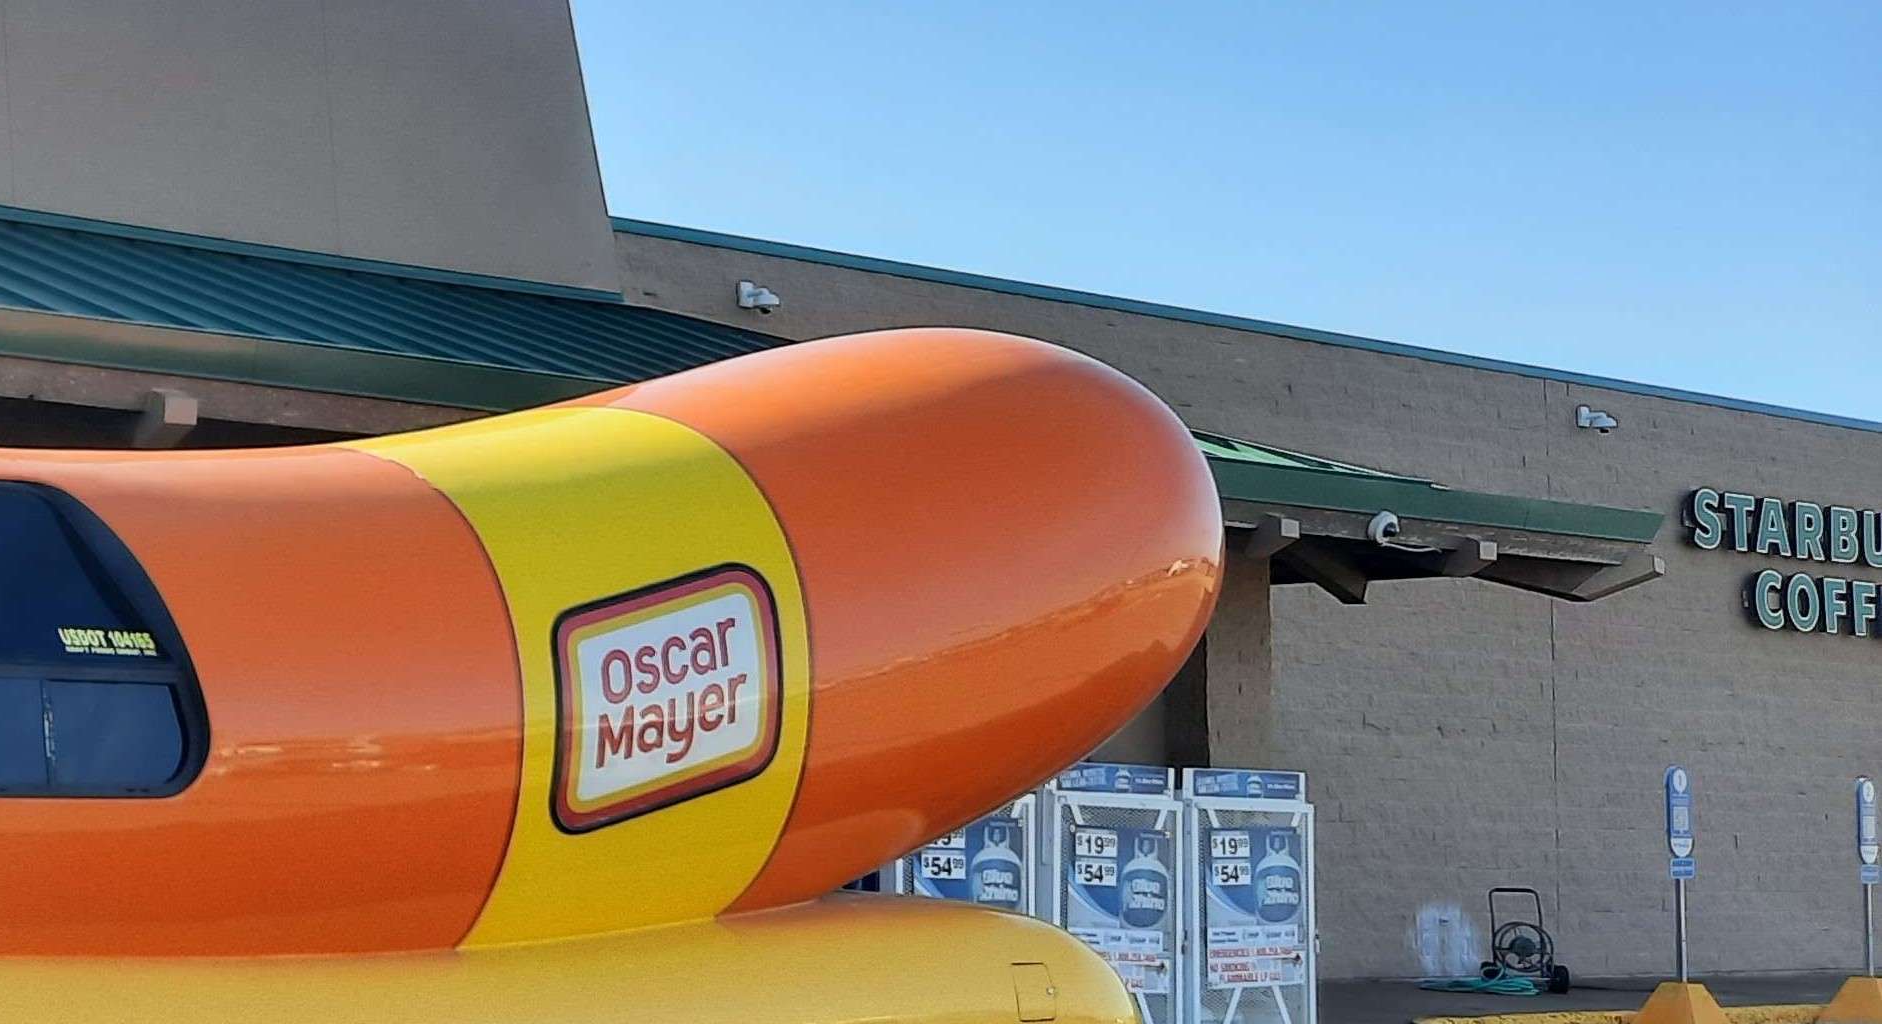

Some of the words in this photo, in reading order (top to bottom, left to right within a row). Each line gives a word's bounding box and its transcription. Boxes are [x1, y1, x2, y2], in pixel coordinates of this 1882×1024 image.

[57, 627, 108, 648] USDOT
[600, 616, 736, 705] Oscar
[594, 673, 747, 769] Mayer
